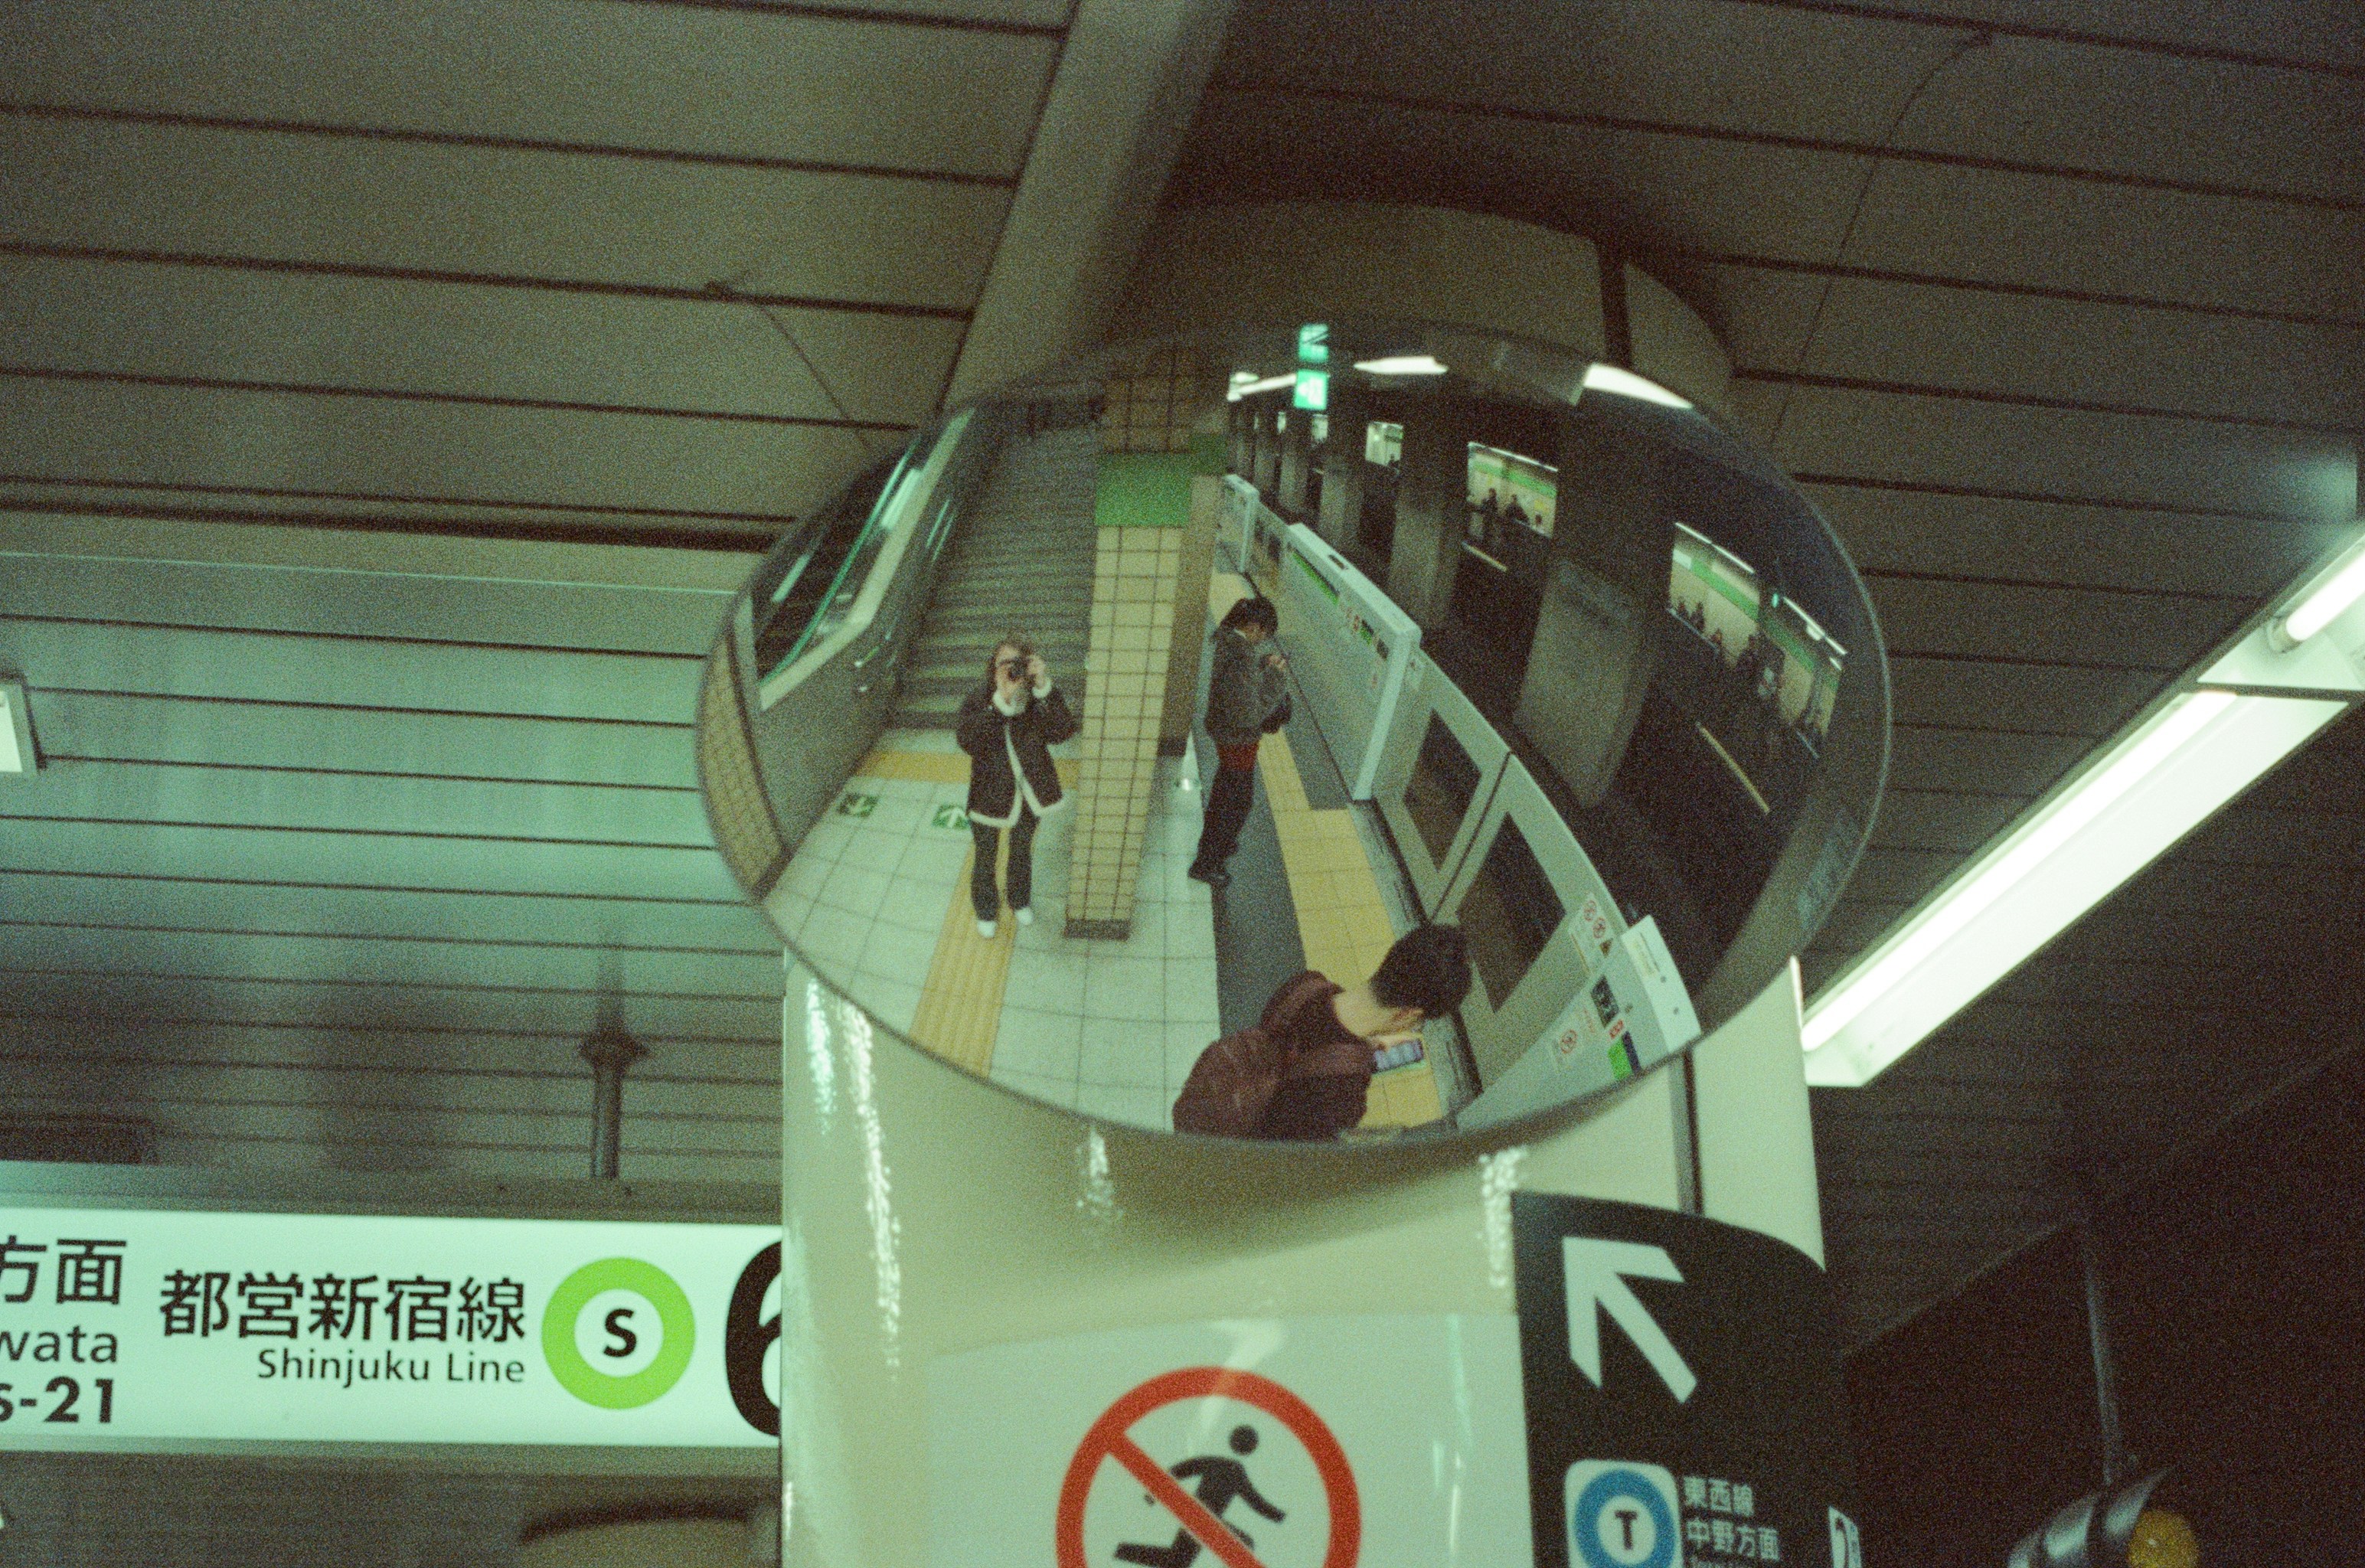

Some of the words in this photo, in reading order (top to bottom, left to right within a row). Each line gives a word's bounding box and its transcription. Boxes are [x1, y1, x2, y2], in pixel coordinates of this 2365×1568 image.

[0, 1234, 126, 1305] 方面
[159, 1269, 526, 1344] 都営新宿線
[603, 1307, 638, 1359] S
[257, 1347, 430, 1390] Shinjuku
[446, 1351, 526, 1383] Line
[1614, 1510, 1638, 1551] T
[1686, 1517, 1781, 1563] 中野方面
